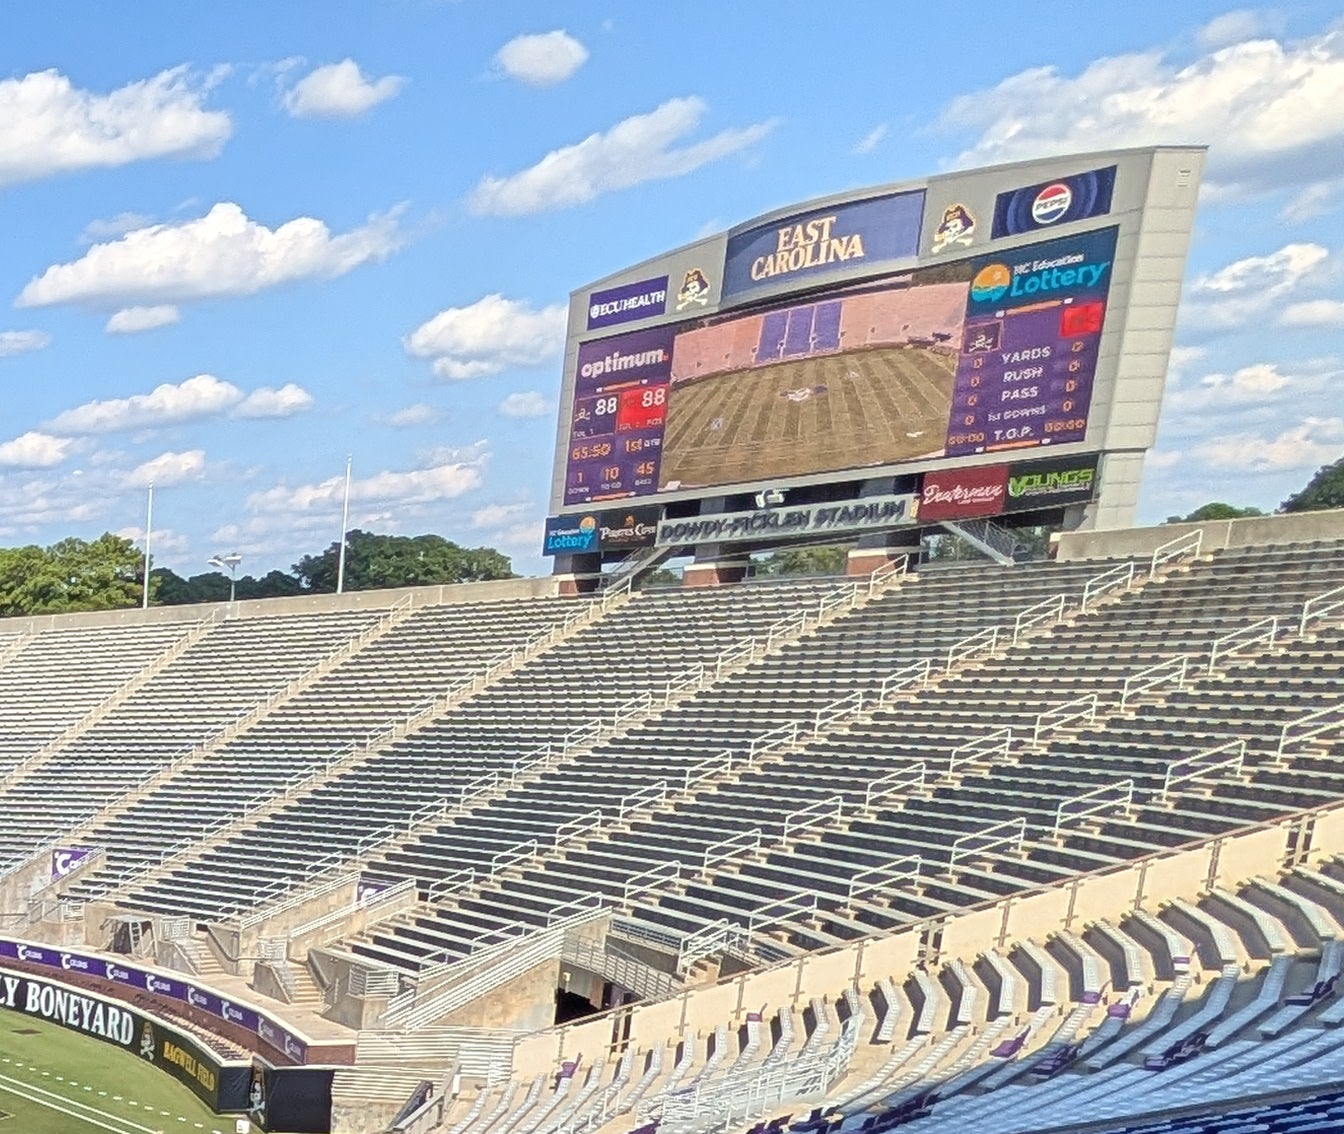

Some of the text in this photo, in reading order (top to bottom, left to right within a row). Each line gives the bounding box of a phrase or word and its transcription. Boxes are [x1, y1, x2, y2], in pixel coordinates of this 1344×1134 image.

[777, 216, 837, 252] EAST
[751, 234, 864, 281] CAROLINA
[1011, 263, 1105, 297] Lottery
[623, 290, 665, 310] HEALTH
[1002, 346, 1052, 363] YARDS
[1003, 366, 1044, 382] RUSH
[642, 388, 665, 407] 88
[1001, 386, 1039, 401] PASS
[595, 397, 617, 416] 88
[815, 501, 905, 527] STADIUM
[548, 534, 594, 549] Lottery
[25, 981, 134, 1045] BONEYARD
[197, 1063, 215, 1091] FIELD
